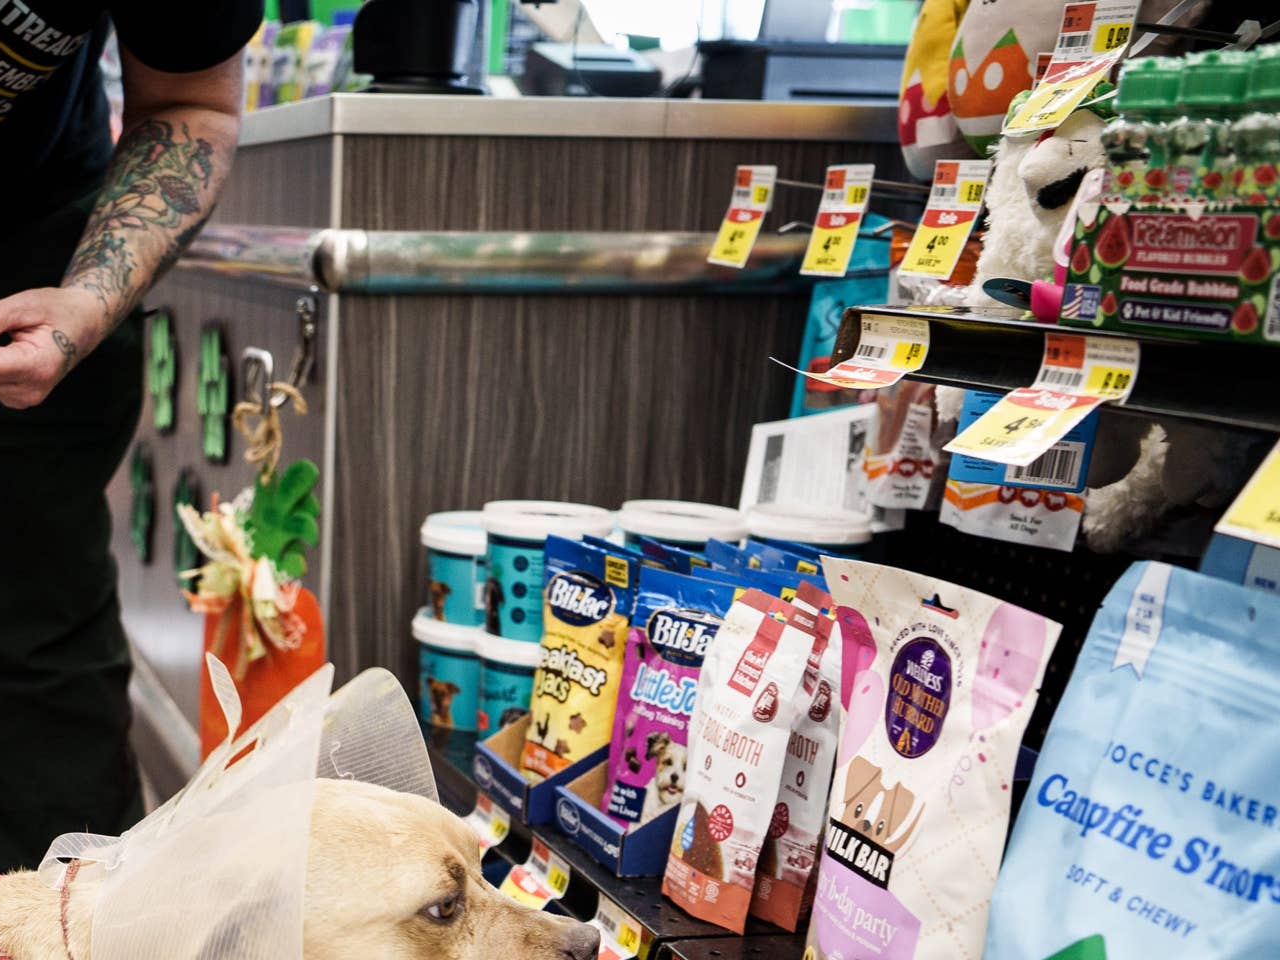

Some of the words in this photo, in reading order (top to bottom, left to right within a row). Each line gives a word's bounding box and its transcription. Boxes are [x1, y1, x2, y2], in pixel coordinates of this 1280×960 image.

[1120, 276, 1147, 293] Food
[1150, 279, 1185, 296] Grade
[1188, 281, 1240, 299] Bubbles
[722, 729, 764, 767] BROTH
[1201, 780, 1280, 831] BAKER
[853, 848, 891, 882] BAR
[1066, 863, 1106, 894] SOFT
[1126, 895, 1199, 938] CHEWY
[853, 905, 897, 953] party
